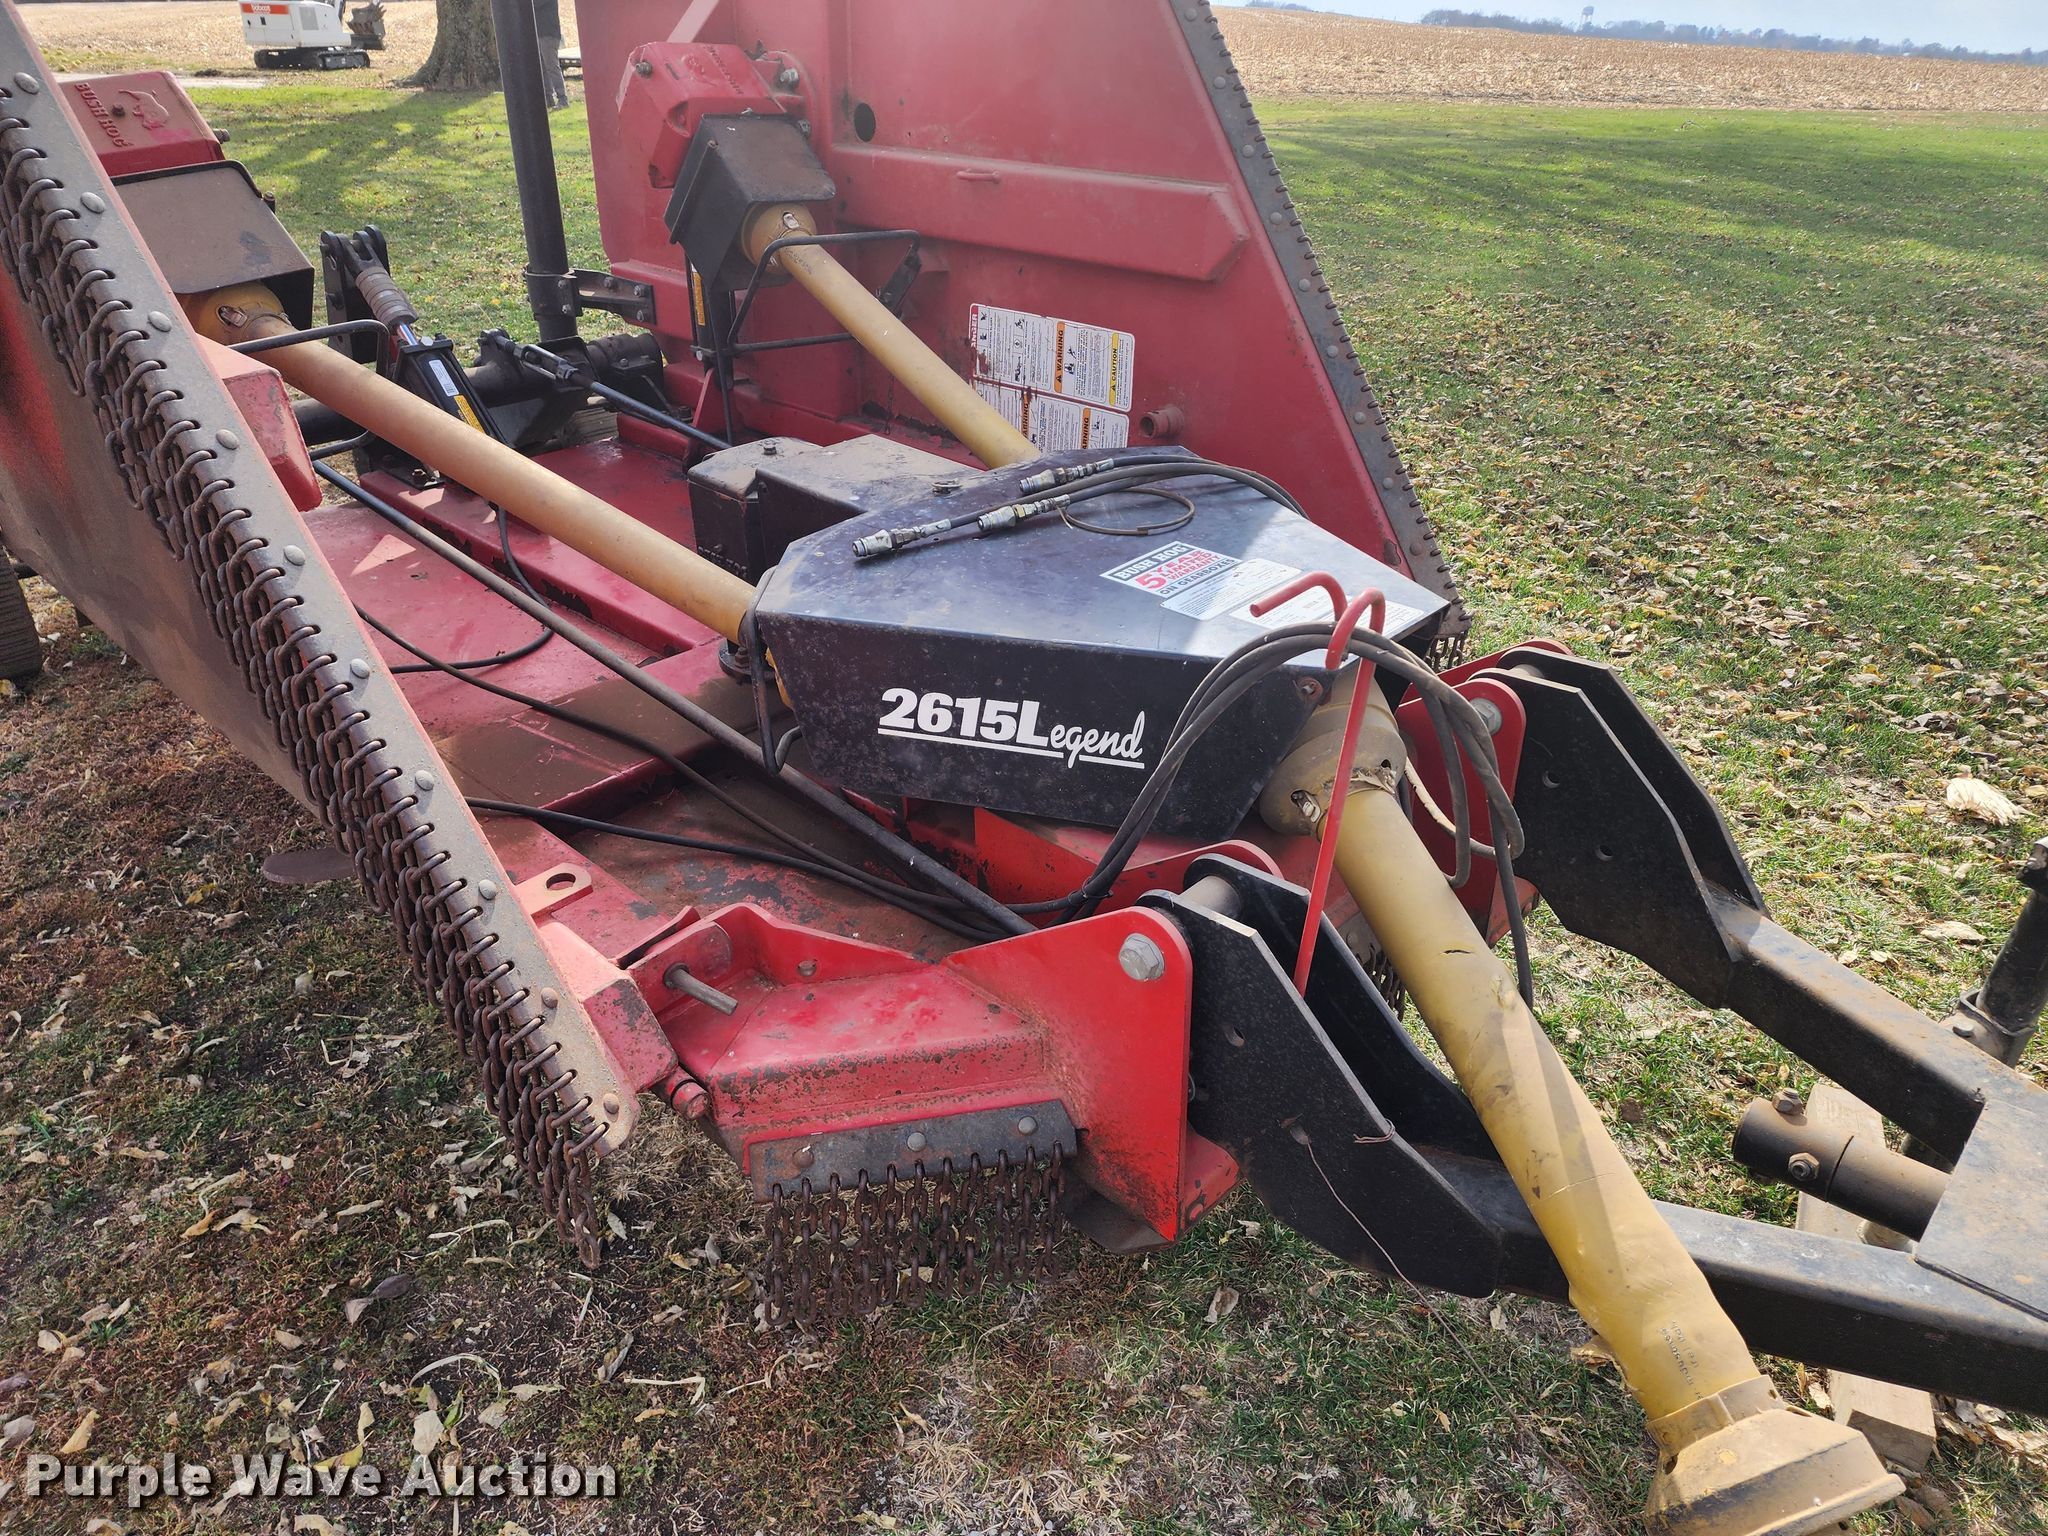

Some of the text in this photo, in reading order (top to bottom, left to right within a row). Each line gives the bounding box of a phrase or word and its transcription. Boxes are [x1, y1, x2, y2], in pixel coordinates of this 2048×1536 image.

[75, 83, 132, 147] BUSH HOG
[1056, 330, 1064, 370] WARNING
[1113, 543, 1189, 579] BUSH HOG
[1160, 553, 1213, 578] LIMITED
[1160, 583, 1179, 595] ON
[1179, 559, 1235, 586] GEARBOXES
[1168, 555, 1221, 581] WARRANTY
[1136, 573, 1167, 589] 5
